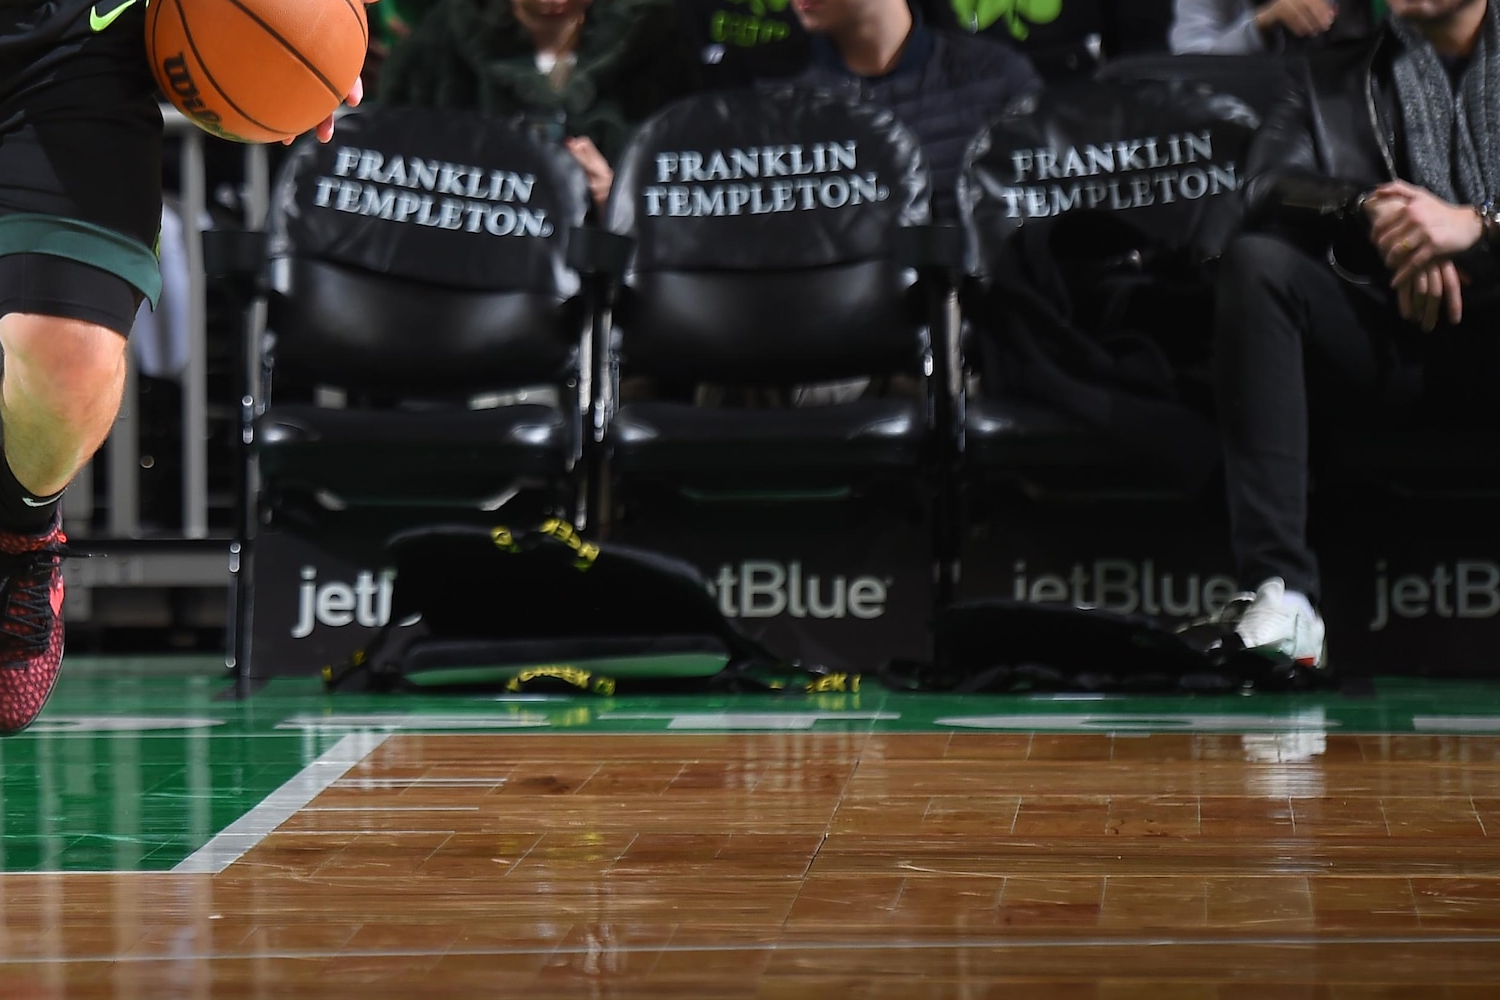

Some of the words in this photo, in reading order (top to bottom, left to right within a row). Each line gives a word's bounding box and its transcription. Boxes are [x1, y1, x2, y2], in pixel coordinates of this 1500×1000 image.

[332, 145, 538, 204] FRANKLIN
[655, 139, 858, 184] FRANKLIN
[1011, 128, 1214, 184] FRANKLIN
[714, 558, 889, 620] tBlue
